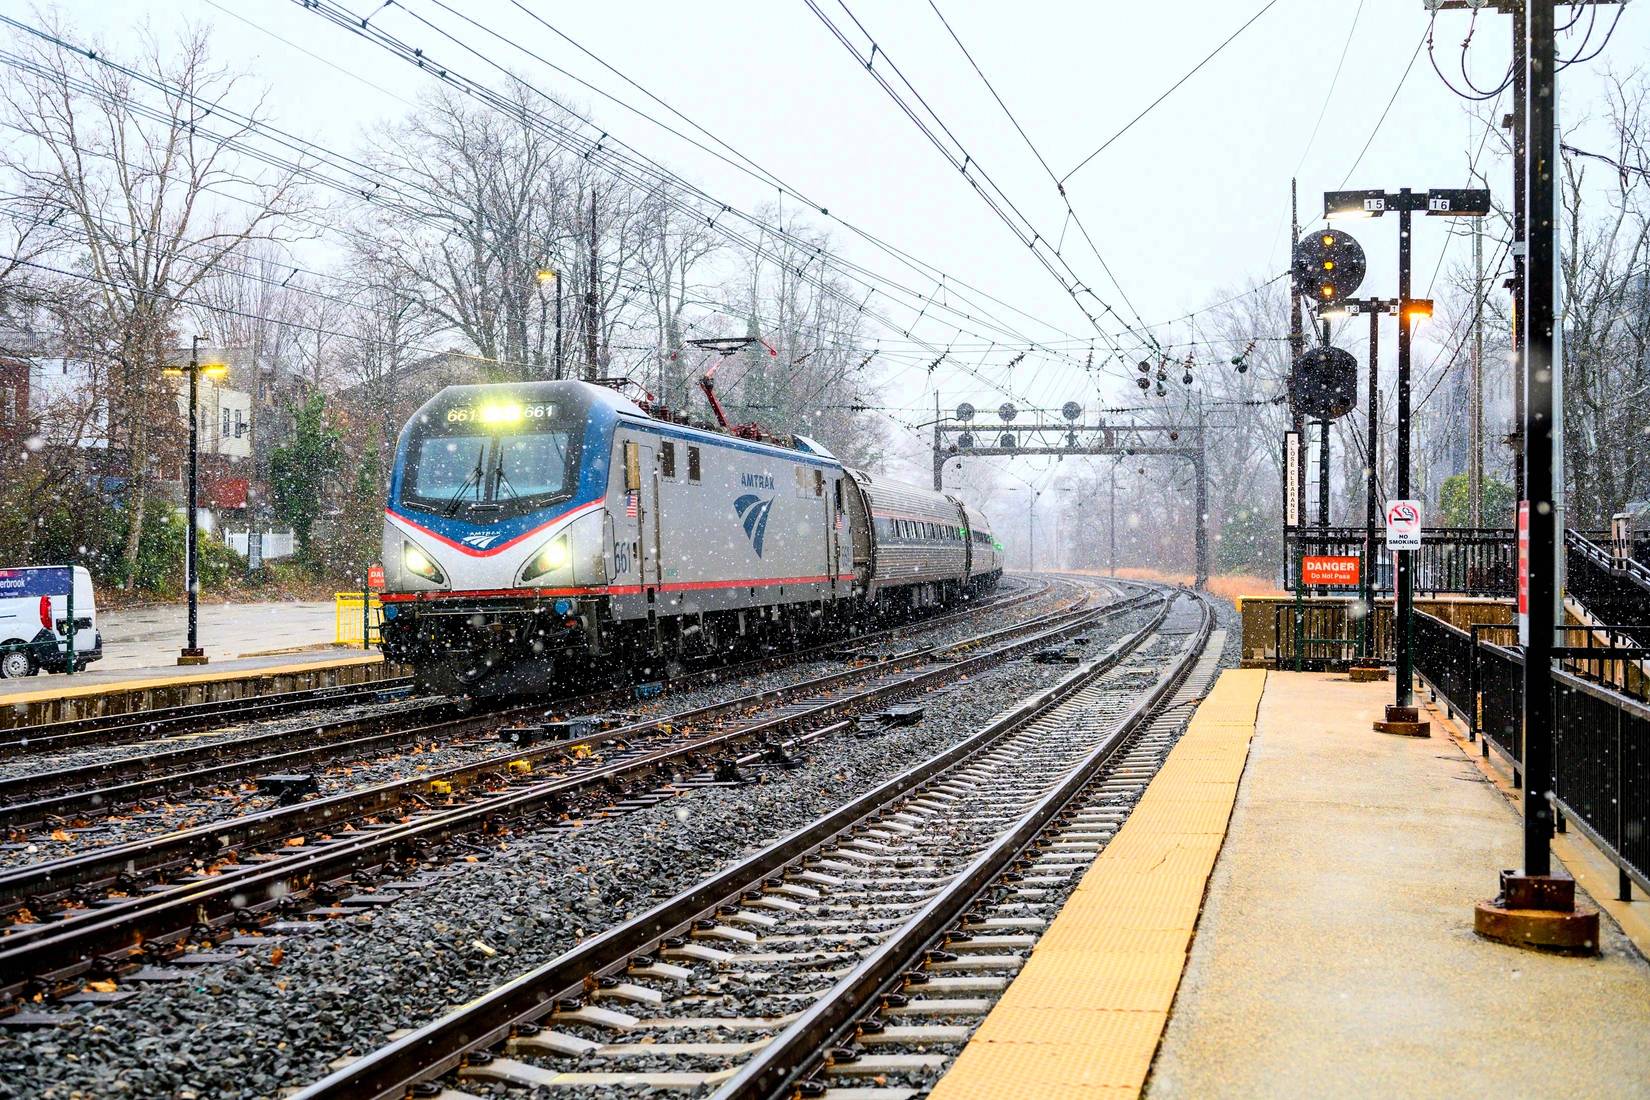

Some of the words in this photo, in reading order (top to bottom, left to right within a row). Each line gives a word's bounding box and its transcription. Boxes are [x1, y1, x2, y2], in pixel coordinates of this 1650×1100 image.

[1367, 200, 1382, 209] 15
[1432, 200, 1447, 210] 16
[447, 409, 476, 422] 661
[525, 405, 553, 418] 661
[741, 472, 775, 490] AMTRAK
[614, 542, 631, 573] 661
[1306, 562, 1355, 571] DANGER
